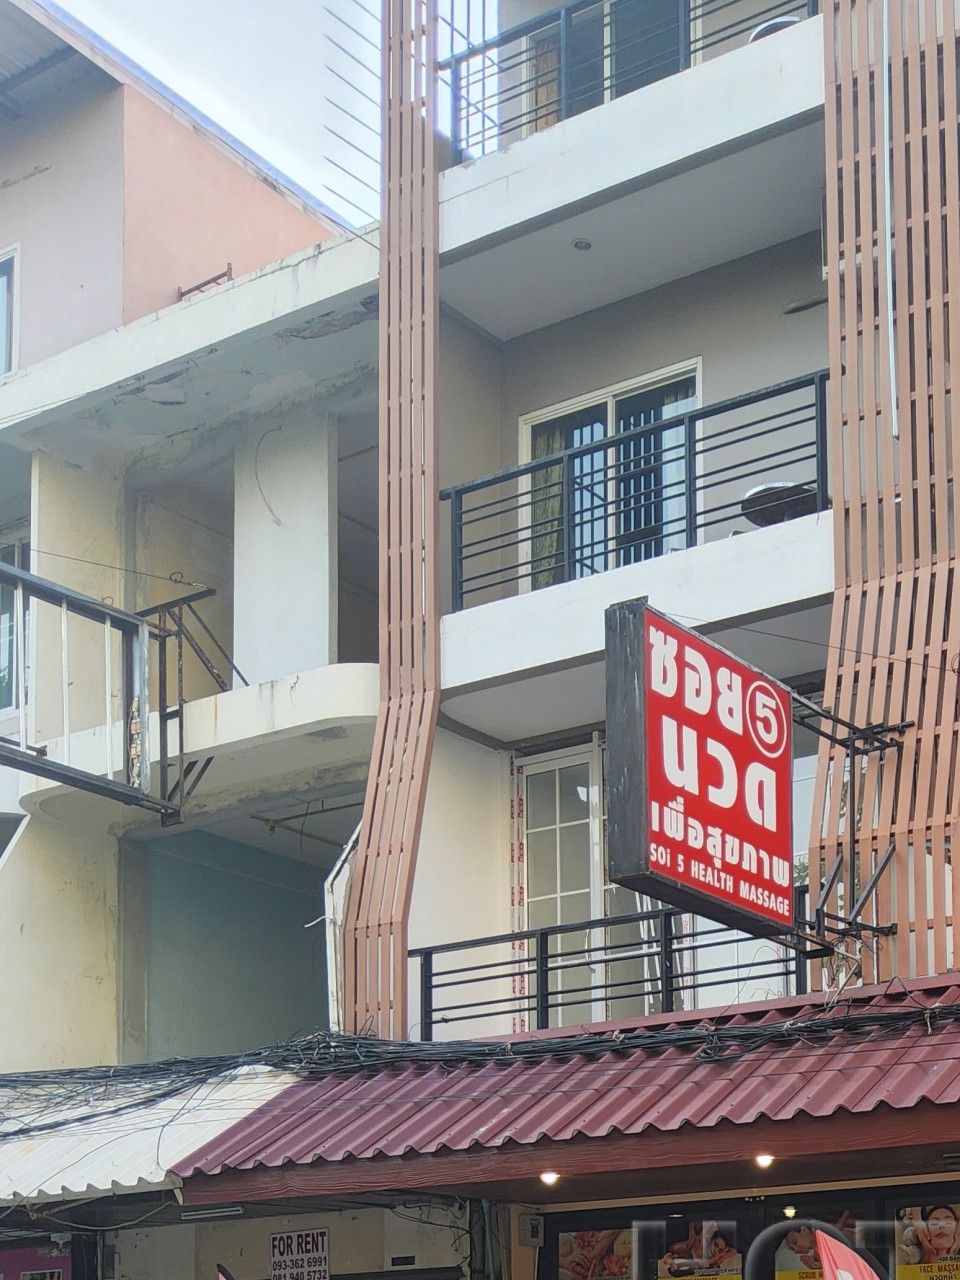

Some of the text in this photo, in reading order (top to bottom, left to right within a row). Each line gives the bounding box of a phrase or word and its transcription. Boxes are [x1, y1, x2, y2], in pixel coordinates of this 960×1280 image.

[650, 626, 743, 736] ซอย
[662, 715, 777, 832] นวด
[651, 796, 789, 888] เพื่อสุขภาพ
[677, 856, 685, 873] 5
[690, 860, 734, 894] HEALTH
[739, 882, 790, 917] MASSAGE
[272, 1231, 326, 1258] FOR RENT
[272, 1256, 327, 1271] 093-362 6991
[307, 1269, 327, 1280] 5732
[919, 1265, 934, 1274] FACE
